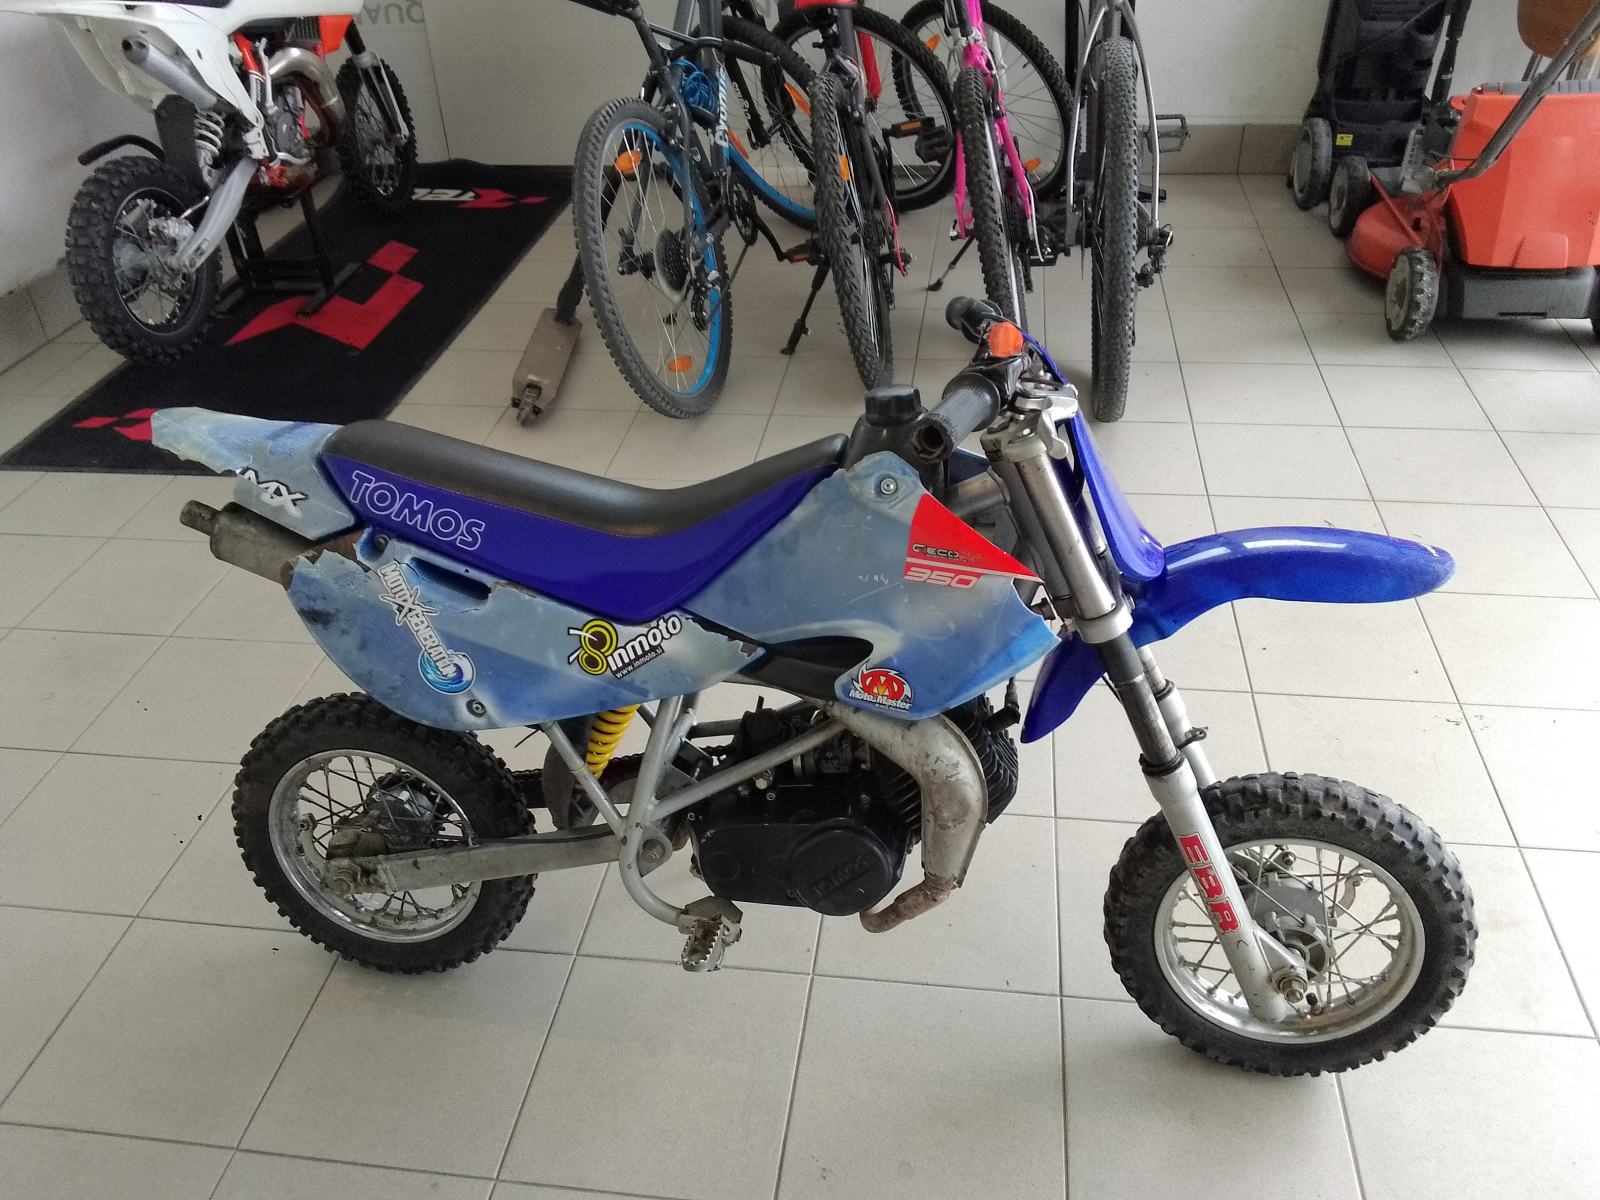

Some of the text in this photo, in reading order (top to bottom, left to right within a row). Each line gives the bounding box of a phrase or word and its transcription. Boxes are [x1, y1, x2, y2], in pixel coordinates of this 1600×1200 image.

[351, 470, 485, 550] TOMOS
[904, 566, 979, 589] 350
[615, 646, 664, 679] www.inmoto.si
[1178, 832, 1240, 933] EBR
